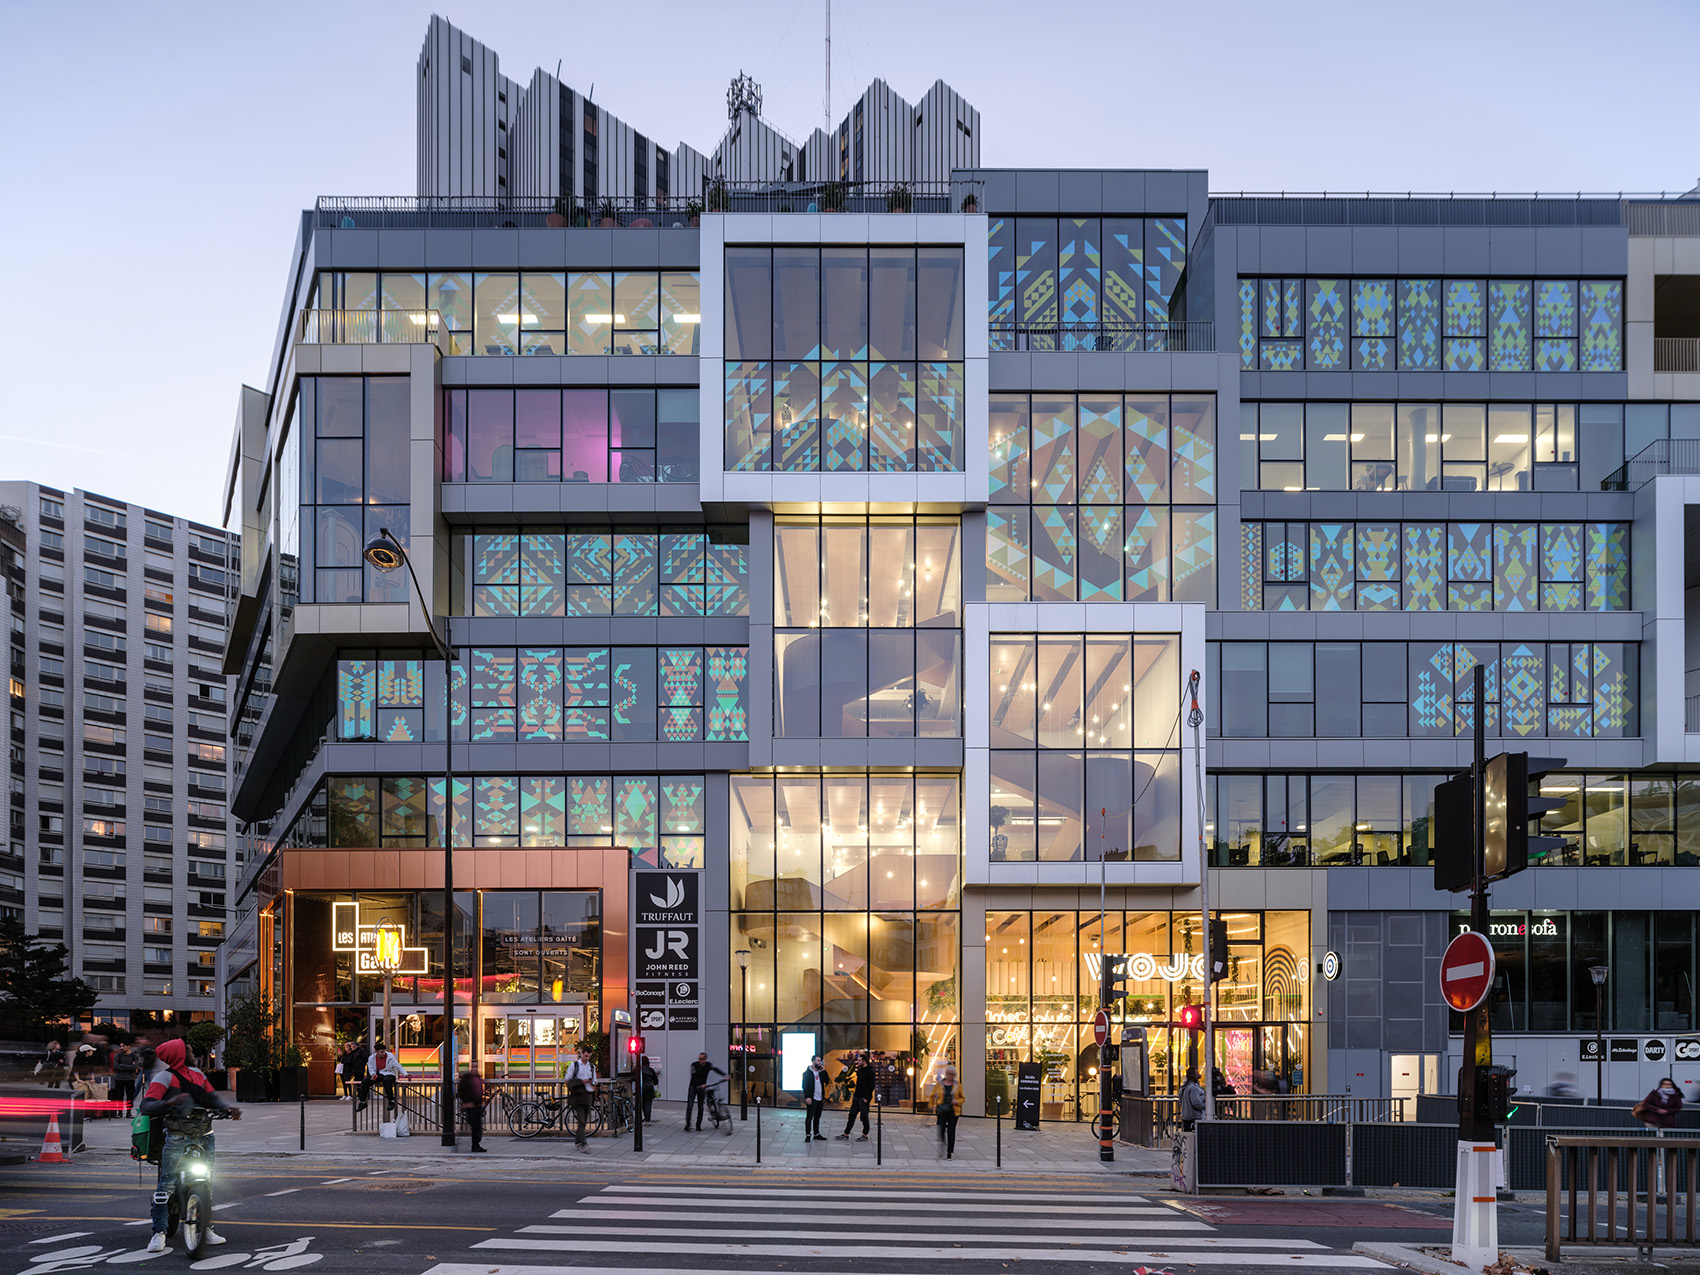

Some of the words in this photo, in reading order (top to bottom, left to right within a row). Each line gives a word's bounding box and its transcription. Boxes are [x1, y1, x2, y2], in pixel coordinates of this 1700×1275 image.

[641, 912, 693, 921] TRUFFAUT
[1459, 918, 1557, 935] proneofà
[645, 930, 690, 960] JR
[1645, 1046, 1665, 1054] DARTY
